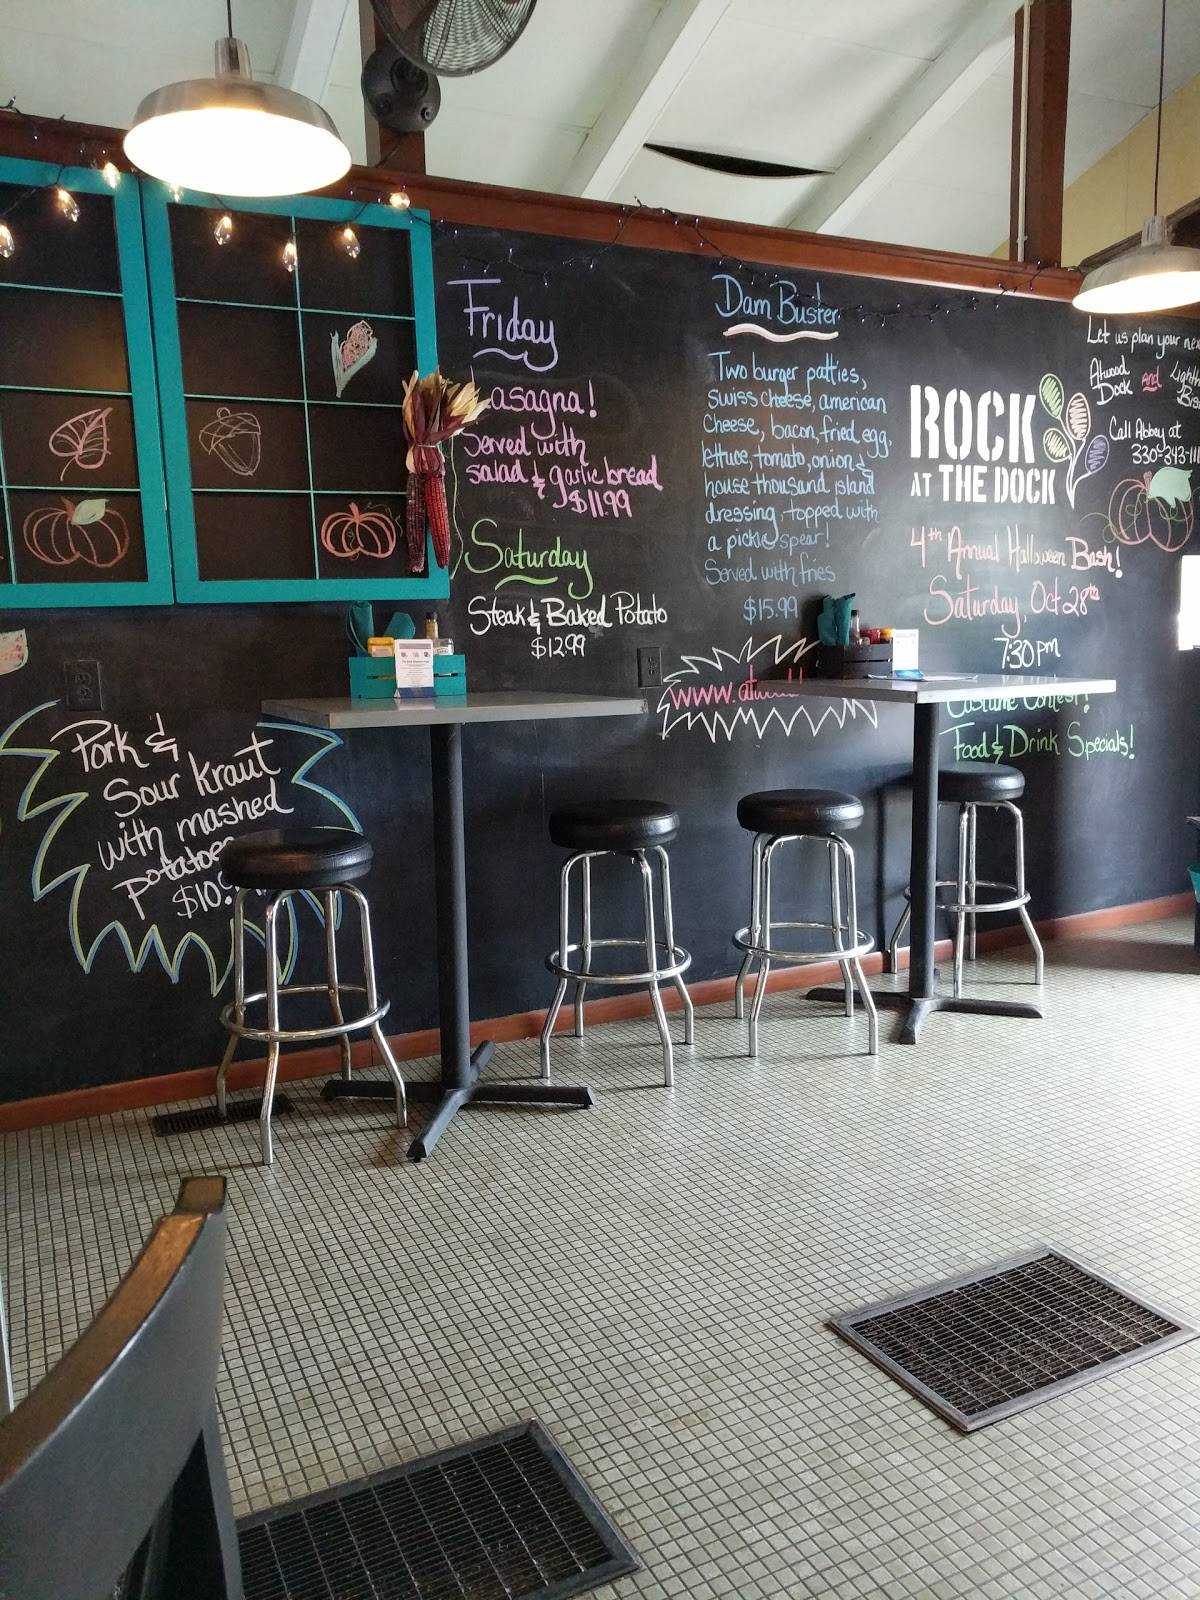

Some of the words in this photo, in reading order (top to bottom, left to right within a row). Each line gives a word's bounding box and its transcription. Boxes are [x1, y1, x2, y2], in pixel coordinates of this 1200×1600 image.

[712, 274, 772, 318] Dam
[769, 280, 839, 325] Buster
[447, 279, 559, 372] Friday
[1087, 315, 1110, 344] Let
[1115, 333, 1128, 345] us
[1131, 327, 1154, 353] plan
[1156, 334, 1181, 359] your
[1183, 338, 1200, 350] nex
[707, 351, 748, 381] Two
[752, 352, 799, 396] burger
[806, 352, 867, 394] patties,
[1090, 355, 1130, 386] Atwood
[1142, 365, 1162, 388] And
[819, 391, 887, 413] american
[1092, 378, 1133, 405] Dock
[461, 426, 530, 457] Served
[538, 421, 589, 466] with
[771, 414, 820, 444] bacon,
[819, 415, 860, 444] fried
[862, 429, 893, 458] egg,
[910, 384, 1037, 464] ROCK
[1110, 416, 1131, 441] Call
[1136, 417, 1166, 452] Abbey
[1168, 420, 1182, 439] at
[702, 440, 753, 471] lettuce,
[752, 443, 812, 472] tomato,
[812, 449, 855, 471] onion
[855, 453, 875, 478] &
[1131, 443, 1200, 465] 330-343-111
[466, 459, 528, 484] salad
[532, 460, 546, 499] &
[549, 465, 604, 508] garlic
[604, 455, 664, 491] bread
[704, 472, 750, 499] house
[751, 471, 831, 497] thousand
[910, 472, 932, 497] AT
[938, 464, 988, 502] THE
[994, 466, 1056, 505] DOCK
[568, 489, 633, 518] $11.99
[783, 497, 843, 529] topped
[846, 500, 880, 524] with
[464, 518, 594, 600] Saturday
[707, 535, 722, 552] a
[727, 528, 776, 559] pickle
[779, 522, 830, 556] spear!
[910, 526, 942, 568] 4th
[947, 526, 999, 580] Annual
[1065, 537, 1123, 578] Bash!
[704, 557, 757, 585] Served
[761, 560, 798, 587] with
[800, 552, 836, 584] fries
[468, 596, 526, 635] Steak
[527, 598, 541, 635] &
[541, 595, 613, 628] Baked
[610, 591, 668, 625] Potato
[743, 594, 799, 625] $15.99
[924, 575, 1027, 639] Saturday,
[1030, 576, 1059, 616] Oct
[1062, 583, 1101, 617] 28th
[531, 634, 586, 659] $12.99
[50, 719, 150, 772] Pork
[145, 712, 179, 761] &
[938, 722, 988, 761] Food
[991, 723, 1004, 764] &
[1002, 724, 1060, 758] Drink
[1067, 721, 1135, 761] Specials!
[103, 777, 181, 817] Sour
[98, 818, 173, 870] with
[177, 777, 294, 841] mashed
